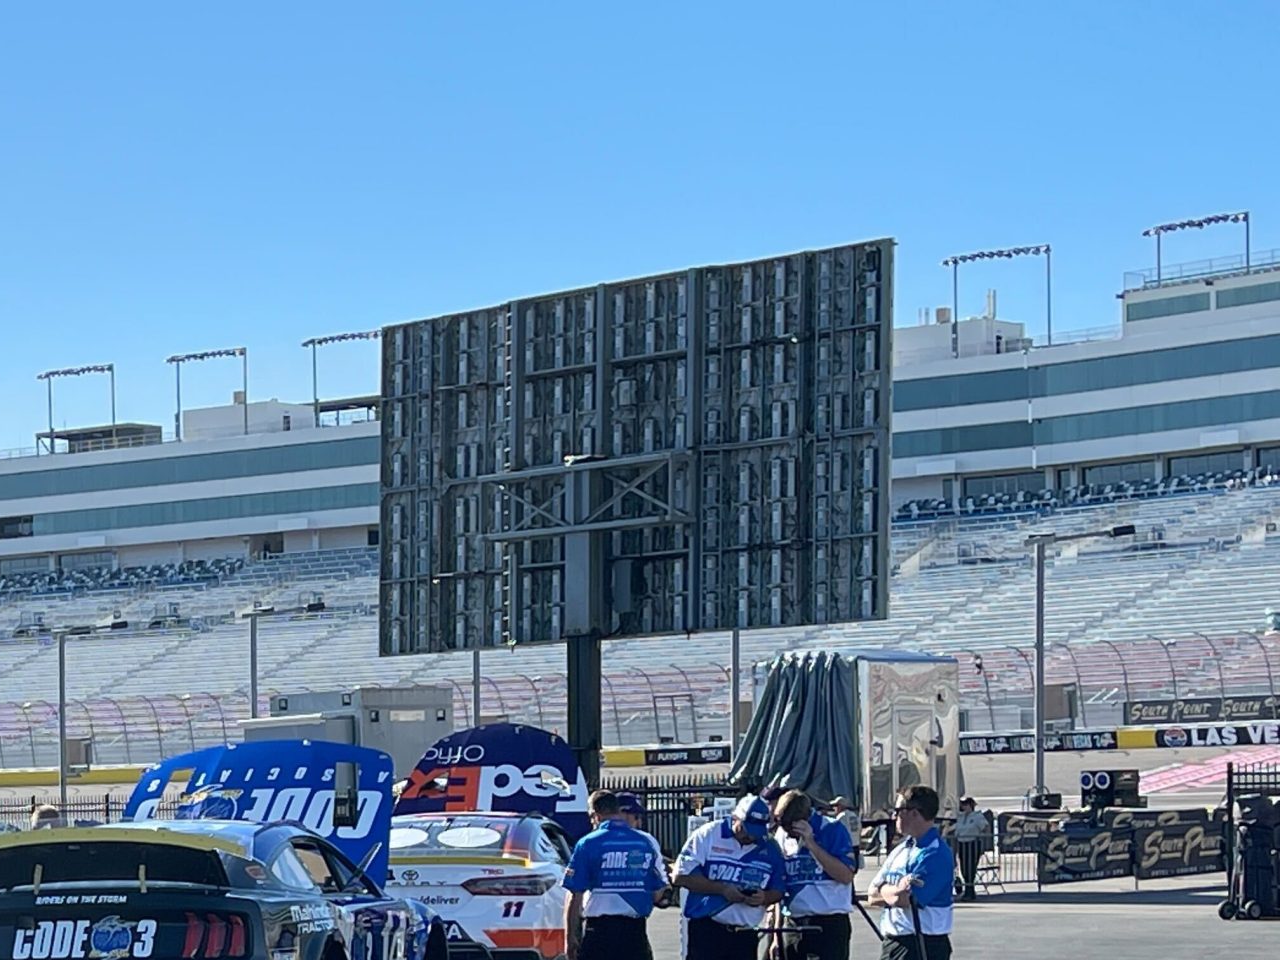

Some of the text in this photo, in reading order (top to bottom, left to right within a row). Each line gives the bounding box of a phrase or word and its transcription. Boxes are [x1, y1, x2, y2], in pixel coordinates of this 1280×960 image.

[1131, 703, 1169, 721] SOUTH
[1171, 702, 1212, 721] POINT
[1191, 727, 1238, 746] LAS
[421, 745, 484, 764] Offic
[147, 766, 389, 793] ASOCIATS
[1045, 831, 1132, 872] SOUTH POINT
[1141, 826, 1224, 869] SOUTH POINT
[708, 863, 742, 882] CODE
[35, 895, 127, 905] RIDERS ON THE STORM
[502, 901, 526, 918] 11
[12, 919, 157, 960] CODE 3
